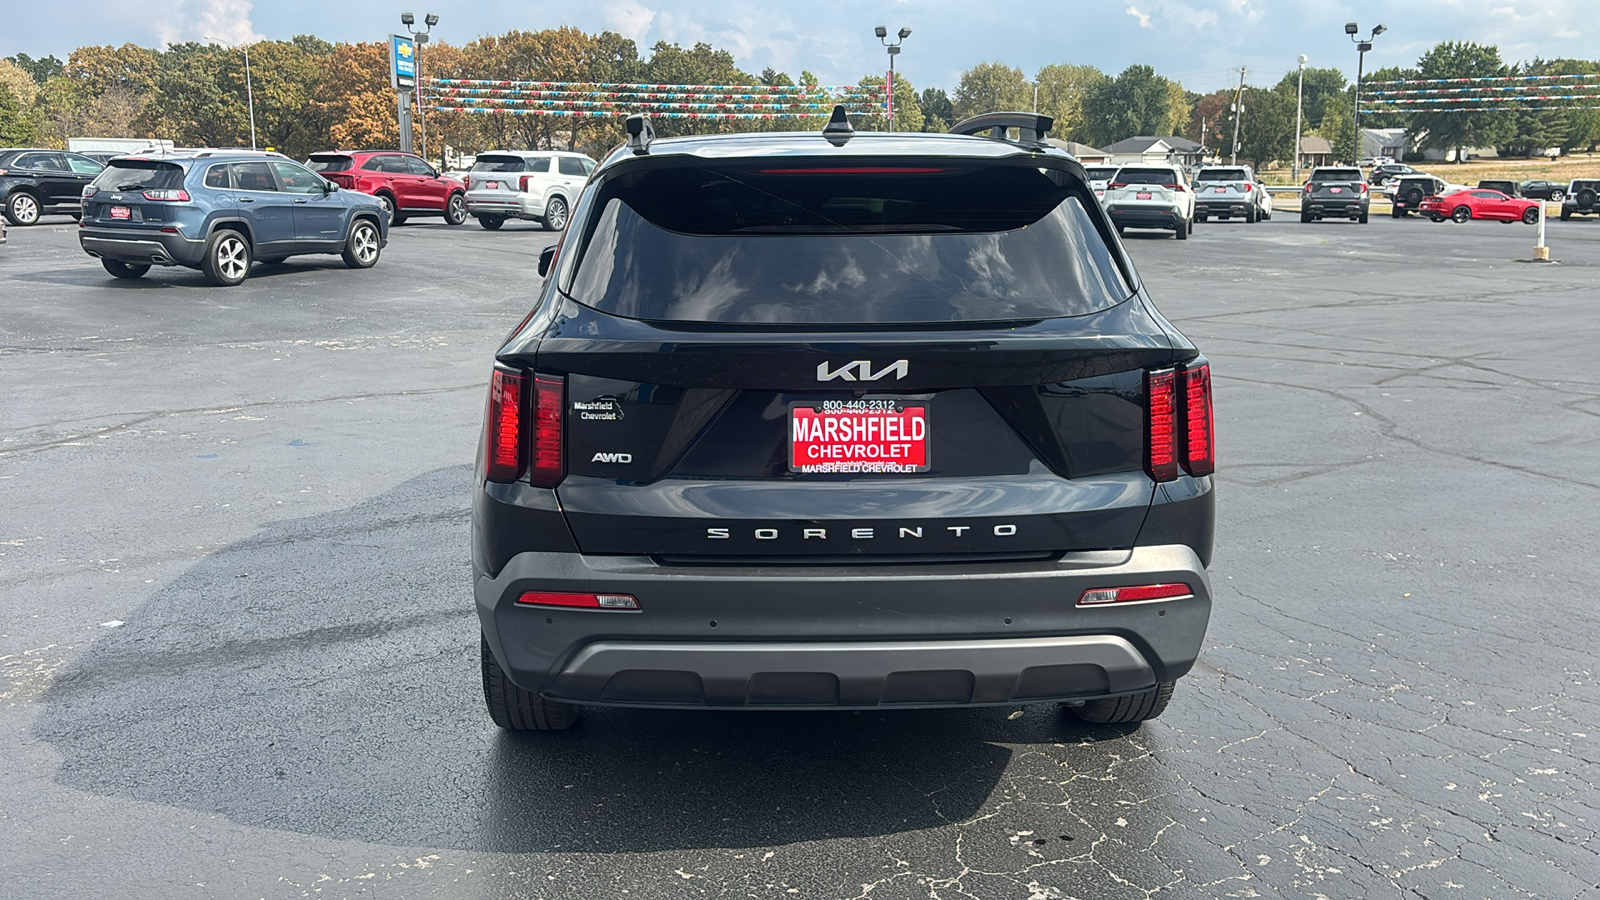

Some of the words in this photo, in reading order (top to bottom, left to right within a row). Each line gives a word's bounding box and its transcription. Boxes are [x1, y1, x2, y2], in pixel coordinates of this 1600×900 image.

[817, 359, 909, 381] KIA
[823, 400, 895, 410] 800-440-2312
[581, 412, 616, 420] Chevrolet
[793, 417, 925, 442] MARSHFIELD
[807, 444, 912, 458] CHEVROLET
[591, 452, 633, 463] AWD
[801, 464, 860, 473] MARSHFIELD
[861, 464, 918, 473] CHEVROLET
[707, 524, 1017, 540] SORENTO
